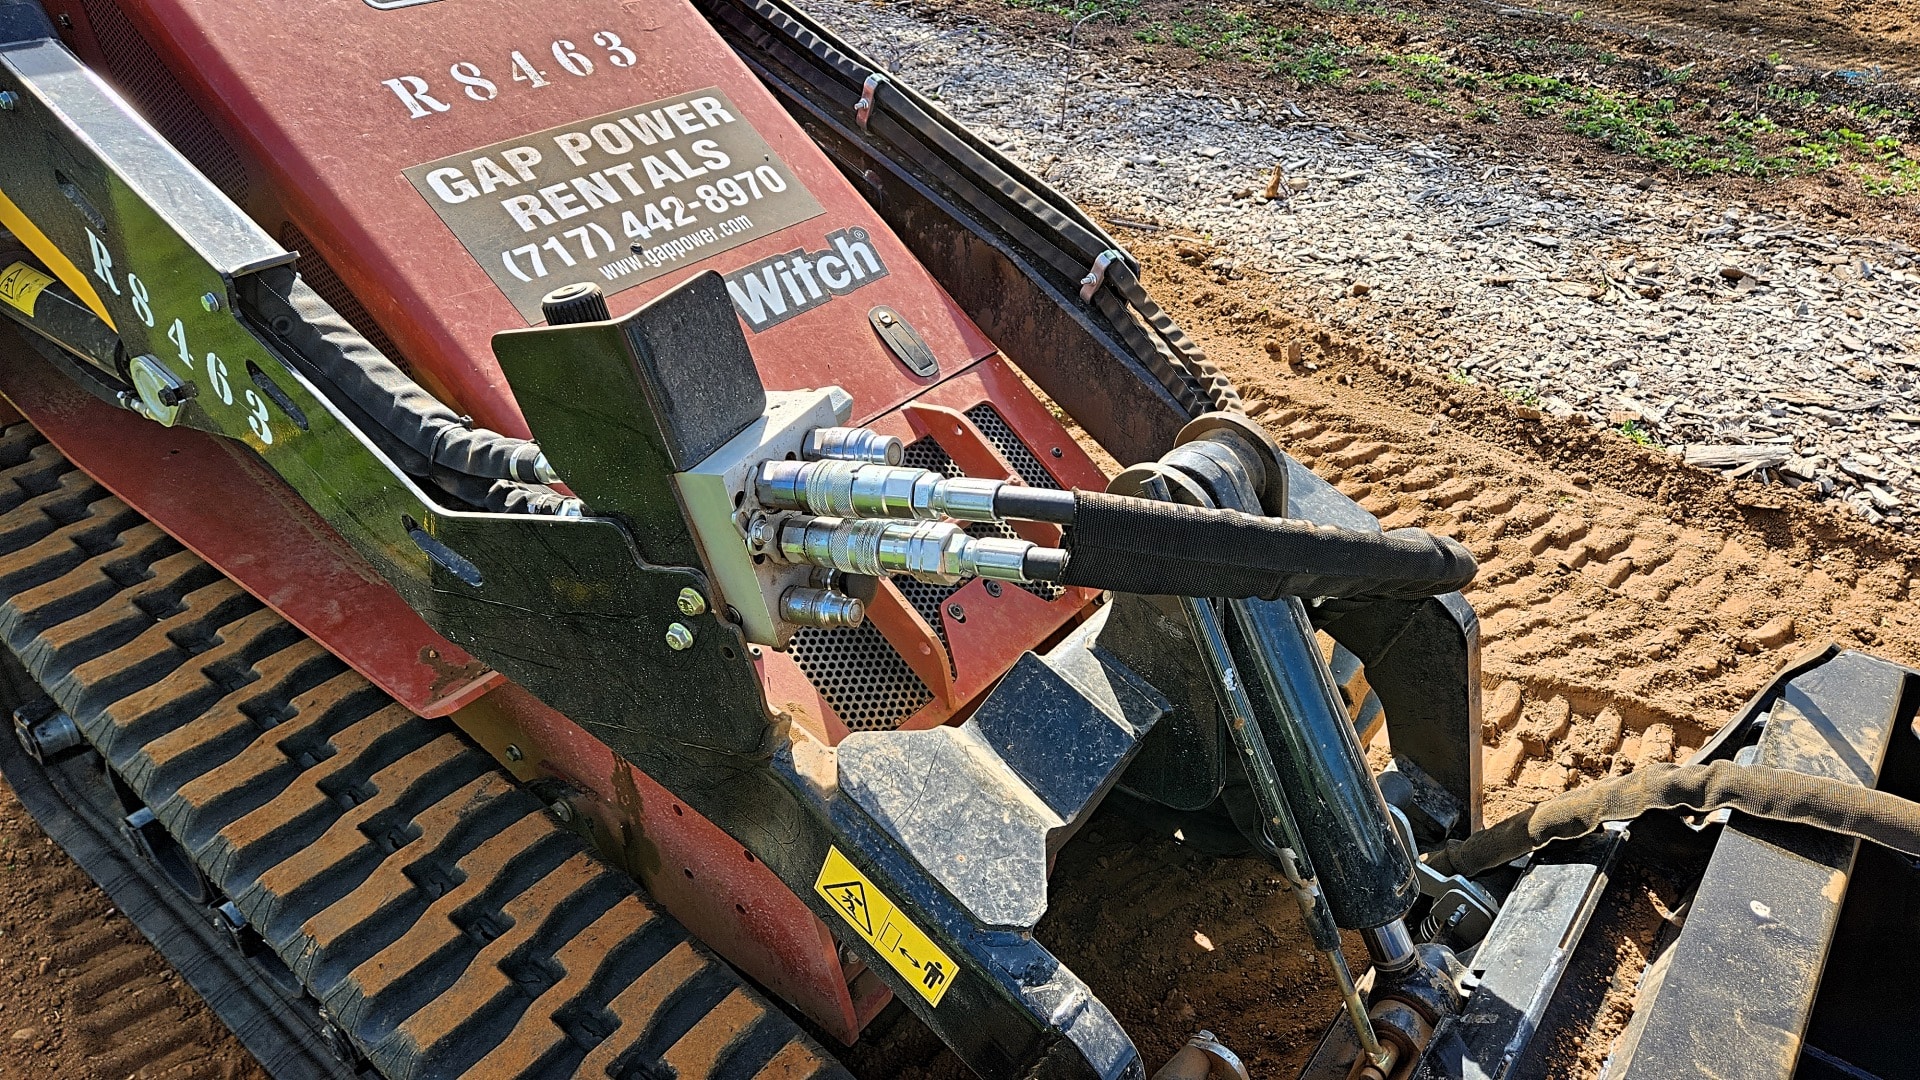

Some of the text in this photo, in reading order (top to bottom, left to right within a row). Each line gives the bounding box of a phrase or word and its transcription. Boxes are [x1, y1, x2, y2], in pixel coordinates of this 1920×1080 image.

[425, 96, 736, 204] GAP POWER
[501, 139, 731, 232] RENTALS
[501, 165, 787, 282] (717) 442-8970
[598, 213, 754, 281] www.gappower.com
